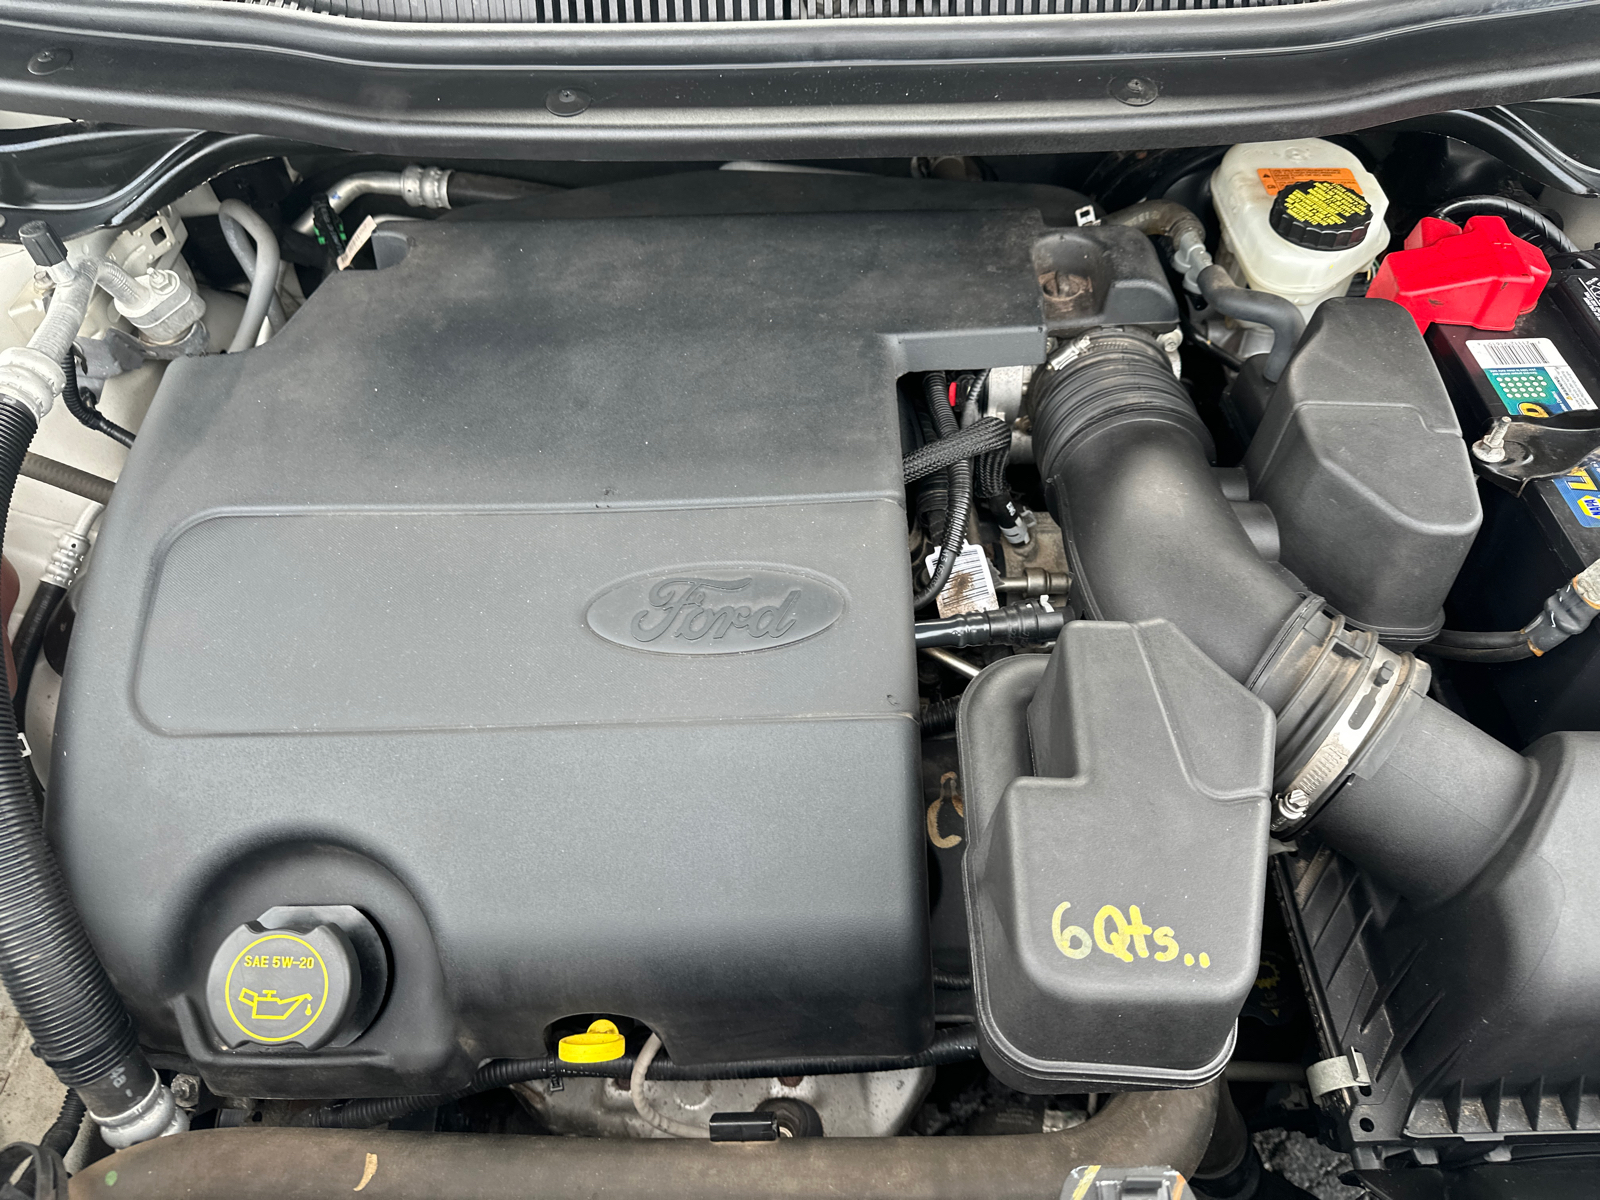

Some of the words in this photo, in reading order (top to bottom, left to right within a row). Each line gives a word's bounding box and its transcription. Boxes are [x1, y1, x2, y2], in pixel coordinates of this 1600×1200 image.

[630, 577, 801, 643] Ford
[244, 955, 269, 968] SAE
[272, 956, 315, 969] 5W-20
